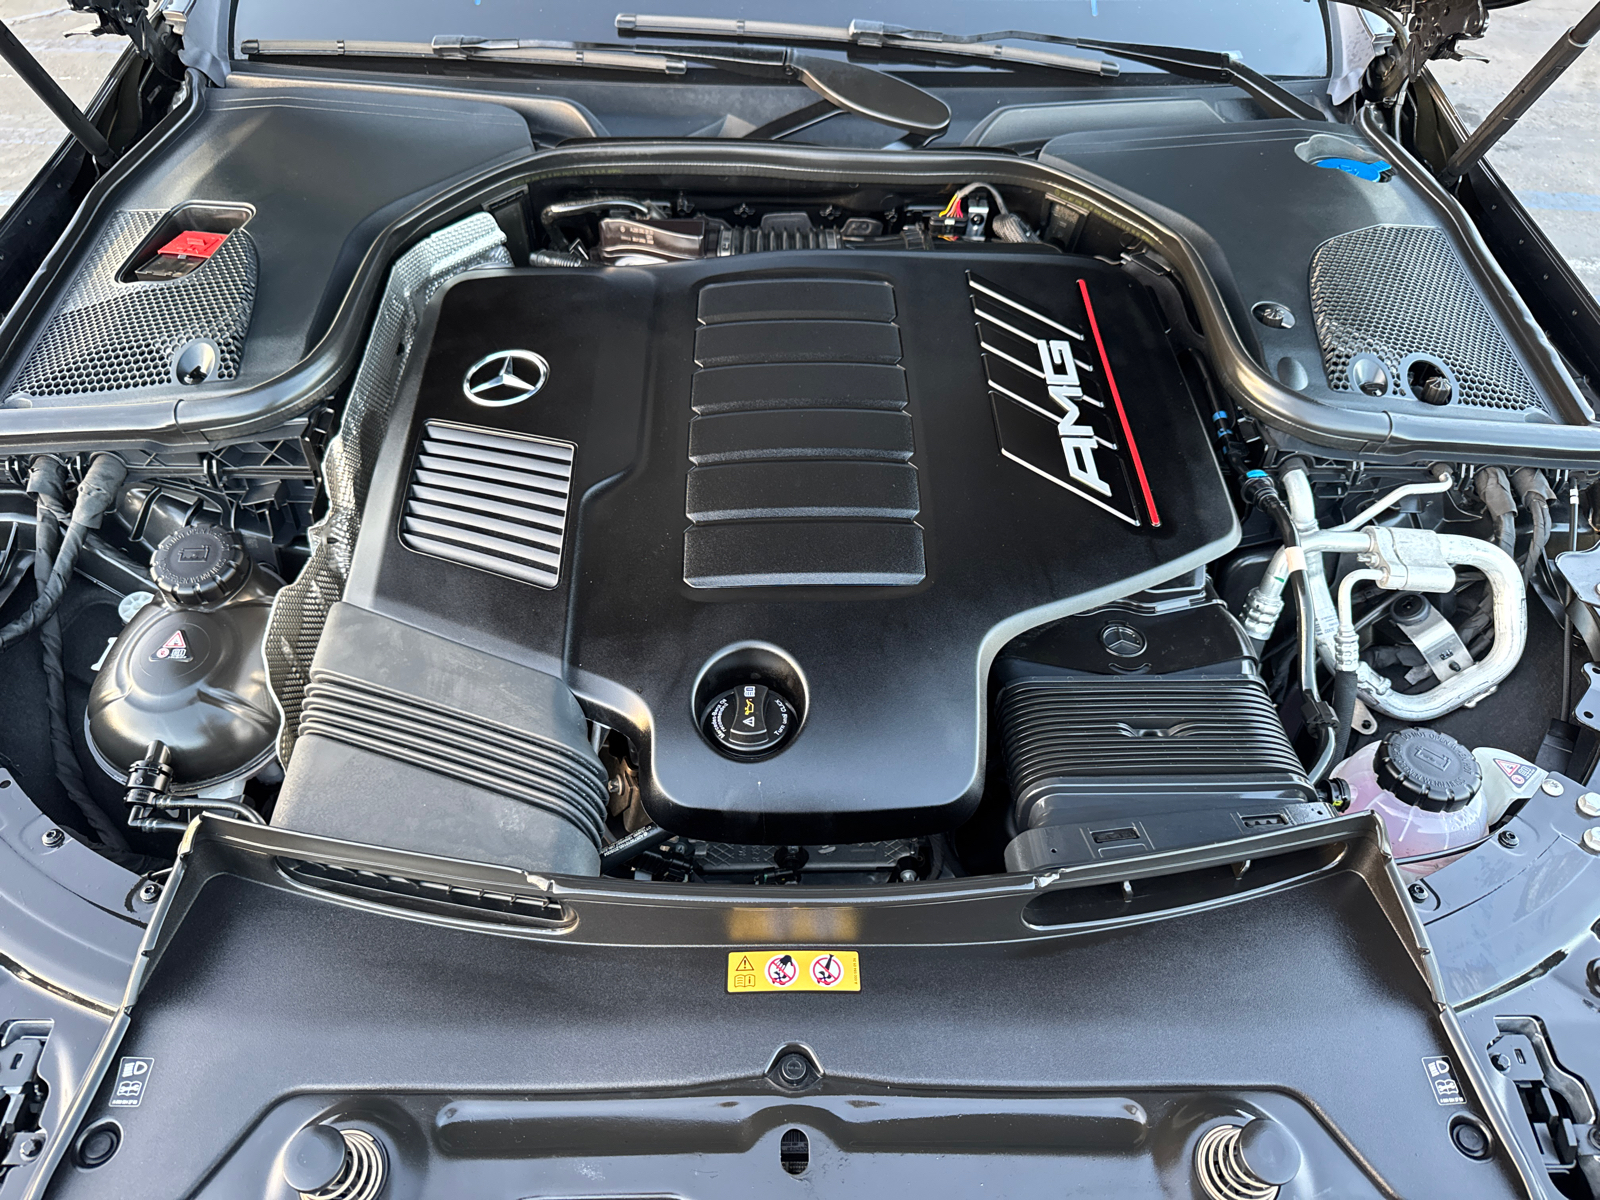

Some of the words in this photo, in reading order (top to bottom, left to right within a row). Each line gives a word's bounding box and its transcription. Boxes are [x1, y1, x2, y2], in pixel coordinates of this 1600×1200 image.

[1037, 339, 1112, 497] AMG
[774, 725, 785, 736] Turn
[1429, 733, 1450, 745] OPEN
